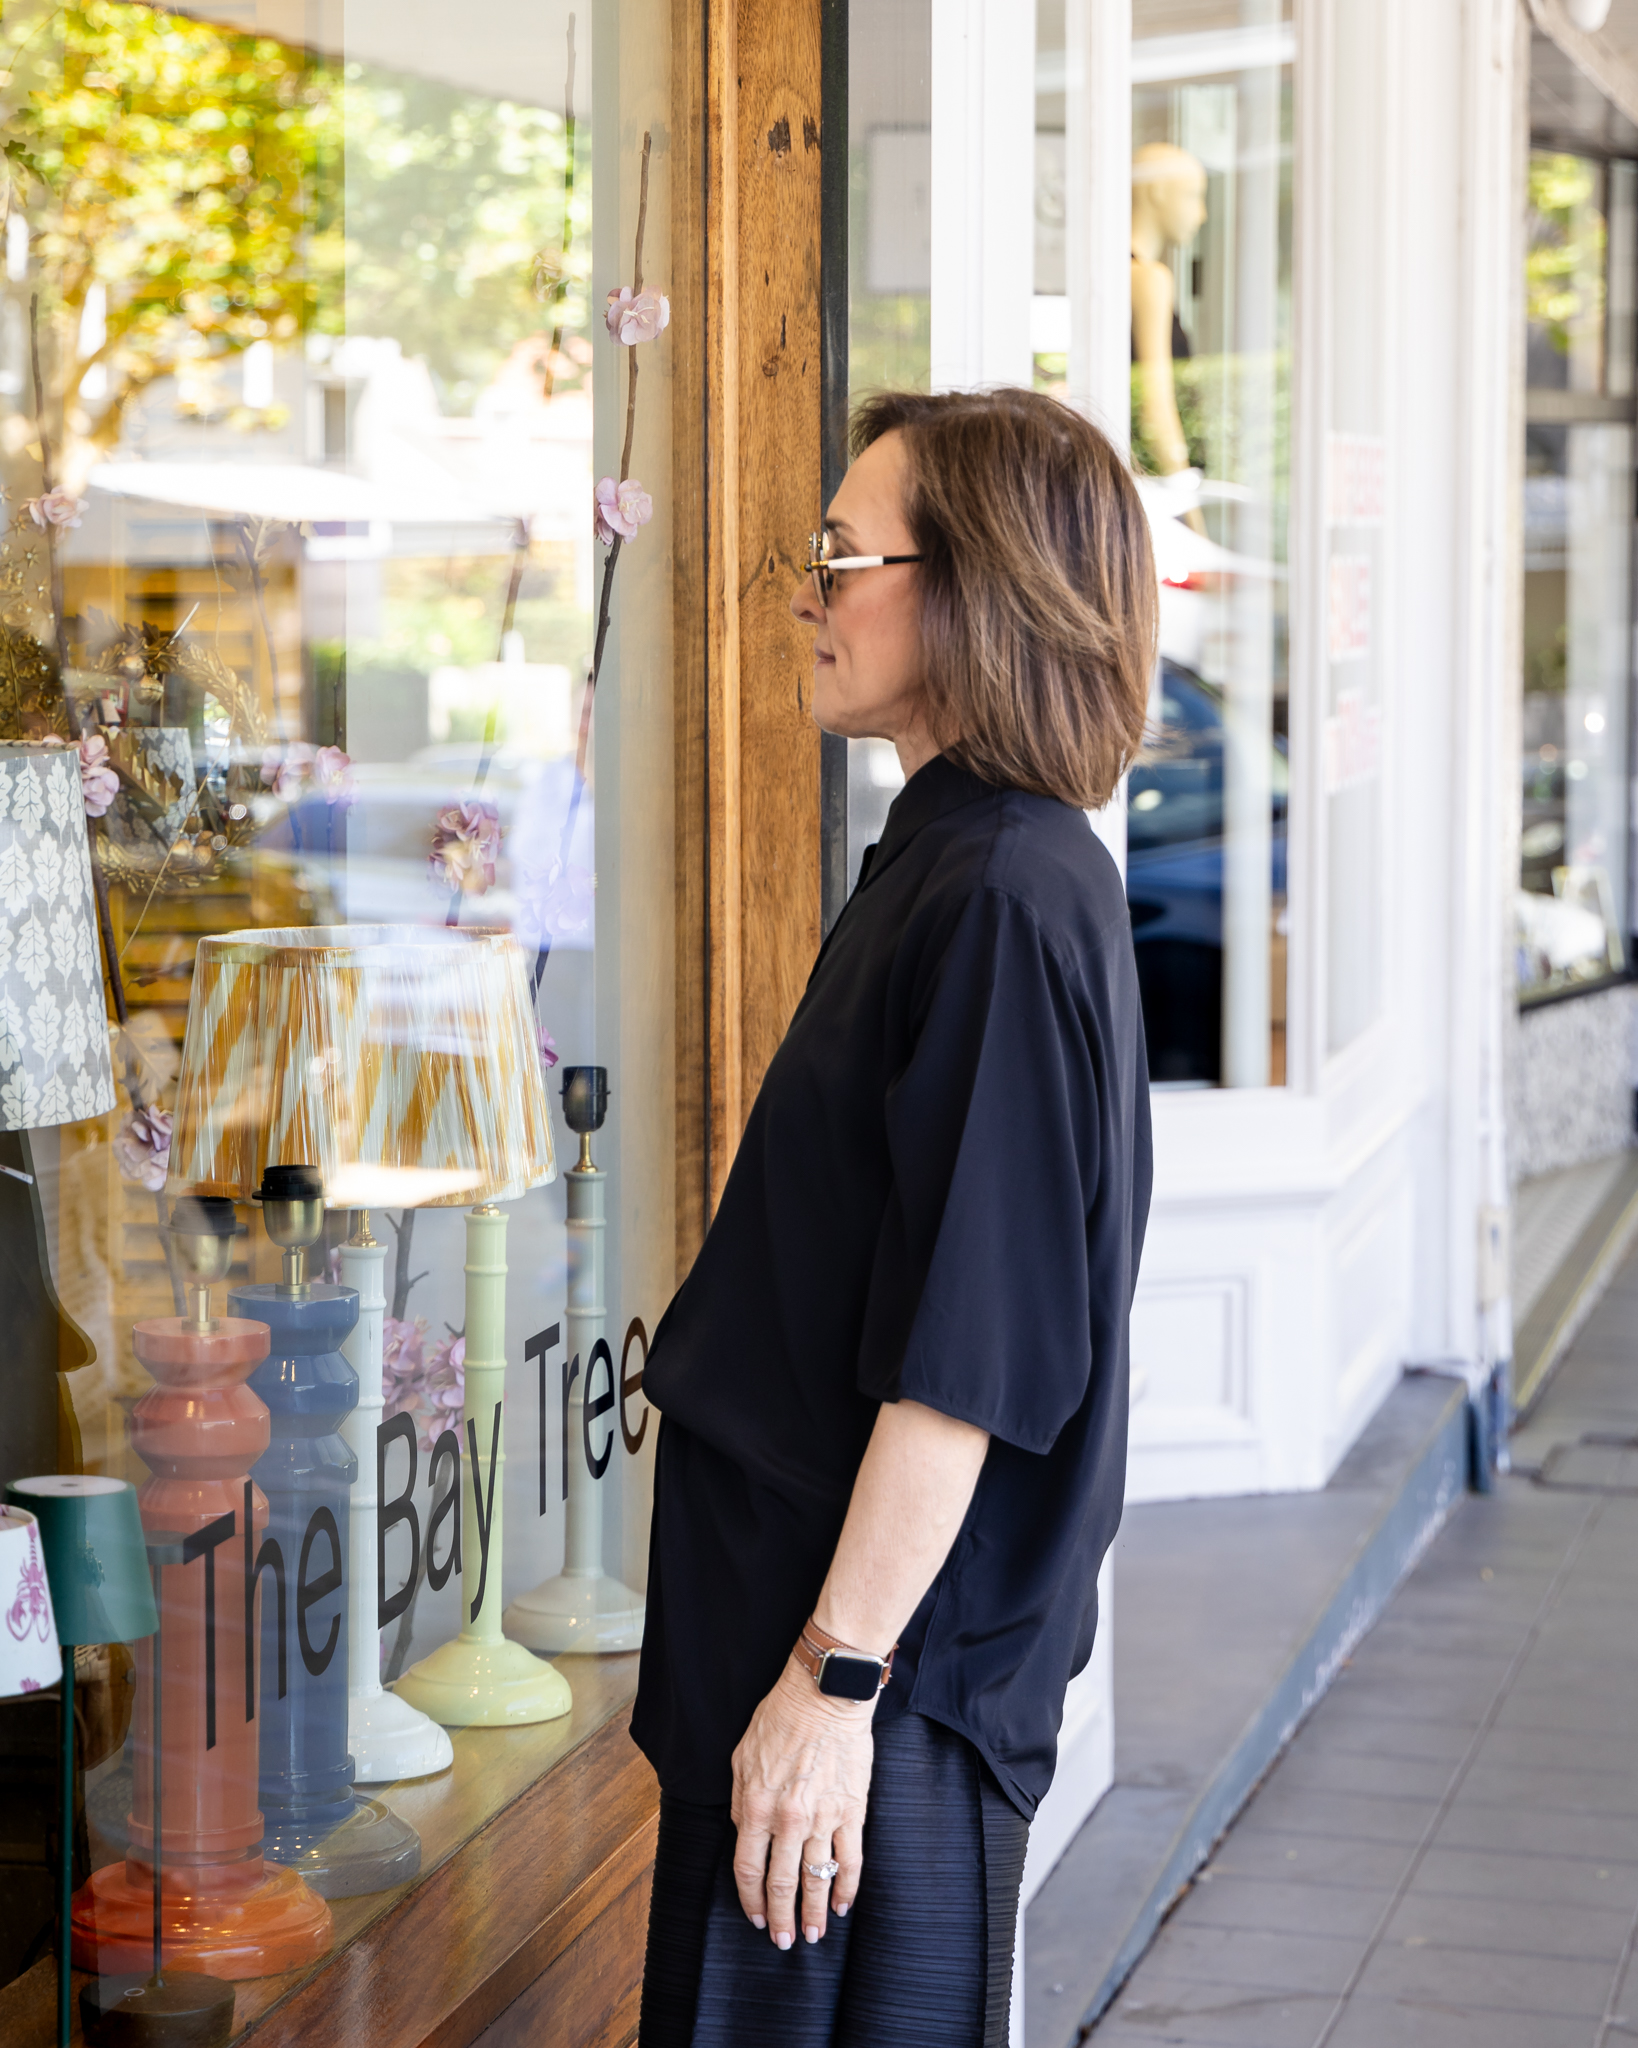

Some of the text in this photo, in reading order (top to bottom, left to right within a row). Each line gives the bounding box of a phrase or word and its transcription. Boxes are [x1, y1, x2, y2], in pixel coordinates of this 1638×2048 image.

[183, 1316, 649, 1751] The Bay Tree
